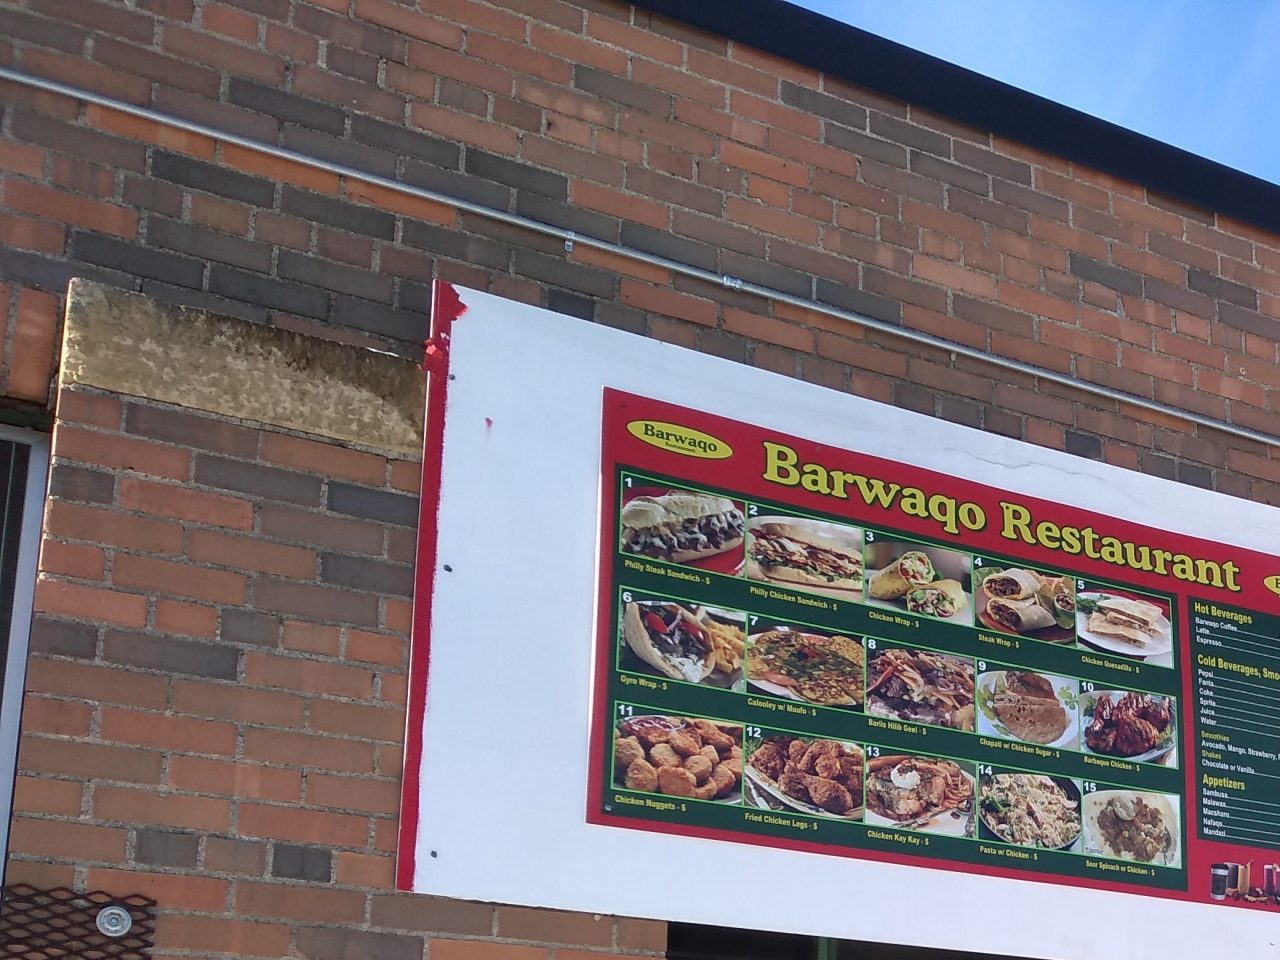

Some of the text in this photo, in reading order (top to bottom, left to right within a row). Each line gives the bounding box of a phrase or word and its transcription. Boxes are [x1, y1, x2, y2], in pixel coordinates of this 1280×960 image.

[643, 422, 717, 455] Barwaqo
[624, 477, 632, 488] 1
[748, 504, 758, 515] 2
[762, 440, 1240, 592] Barwaqo Restaurant
[866, 531, 874, 541] 3
[974, 556, 982, 566] 4
[624, 559, 700, 582] Philly Steak Sandwich
[1077, 579, 1084, 589] 5
[622, 590, 632, 603] 6
[749, 585, 828, 609] Philly Chicken Sandwich
[868, 610, 910, 627] Chicken Wrap
[1194, 601, 1252, 626] Hot Beverages
[749, 615, 758, 626] 7
[1195, 616, 1219, 629] Barwaqo
[1219, 622, 1237, 632] Coffee
[1195, 625, 1209, 635] Latte
[867, 638, 876, 650] 8
[978, 633, 1011, 648] Steak Wrap
[1196, 635, 1221, 648] Espresso
[978, 660, 986, 671] 9
[1081, 655, 1103, 666] Chicken
[1197, 654, 1215, 667] Cold
[1217, 658, 1261, 678] Beverages,
[1198, 668, 1213, 679] Pepsi
[620, 674, 656, 689] Gyro Wrap
[1081, 681, 1094, 692] 10
[1198, 677, 1214, 687] Fanta
[1199, 687, 1213, 696] Coke
[1199, 697, 1216, 707] Sprite
[617, 704, 633, 716] 11
[1200, 706, 1215, 716] Juice
[1200, 716, 1216, 726] Water
[746, 725, 761, 738] 12
[1200, 730, 1229, 742] Smoothies
[866, 745, 879, 757] 13
[1011, 742, 1034, 754] Chicken
[1247, 747, 1277, 761] Strawberry,
[1201, 749, 1221, 760] Shakes
[978, 764, 992, 775] 14
[1110, 759, 1132, 770] Chicken
[1202, 758, 1228, 770] Chocolate
[1236, 764, 1254, 775] Vanilla
[1083, 781, 1096, 792] 15
[1202, 773, 1245, 792] Appetizers
[1202, 787, 1227, 798] Sambusa
[614, 794, 675, 811] Chicken Nuggets
[744, 812, 808, 830] Fried Chicken Legs
[867, 829, 920, 845] Chicken Kay Kay
[979, 845, 996, 854] Pasta
[1005, 848, 1029, 859] Chicken
[1126, 865, 1147, 874] Chicken
